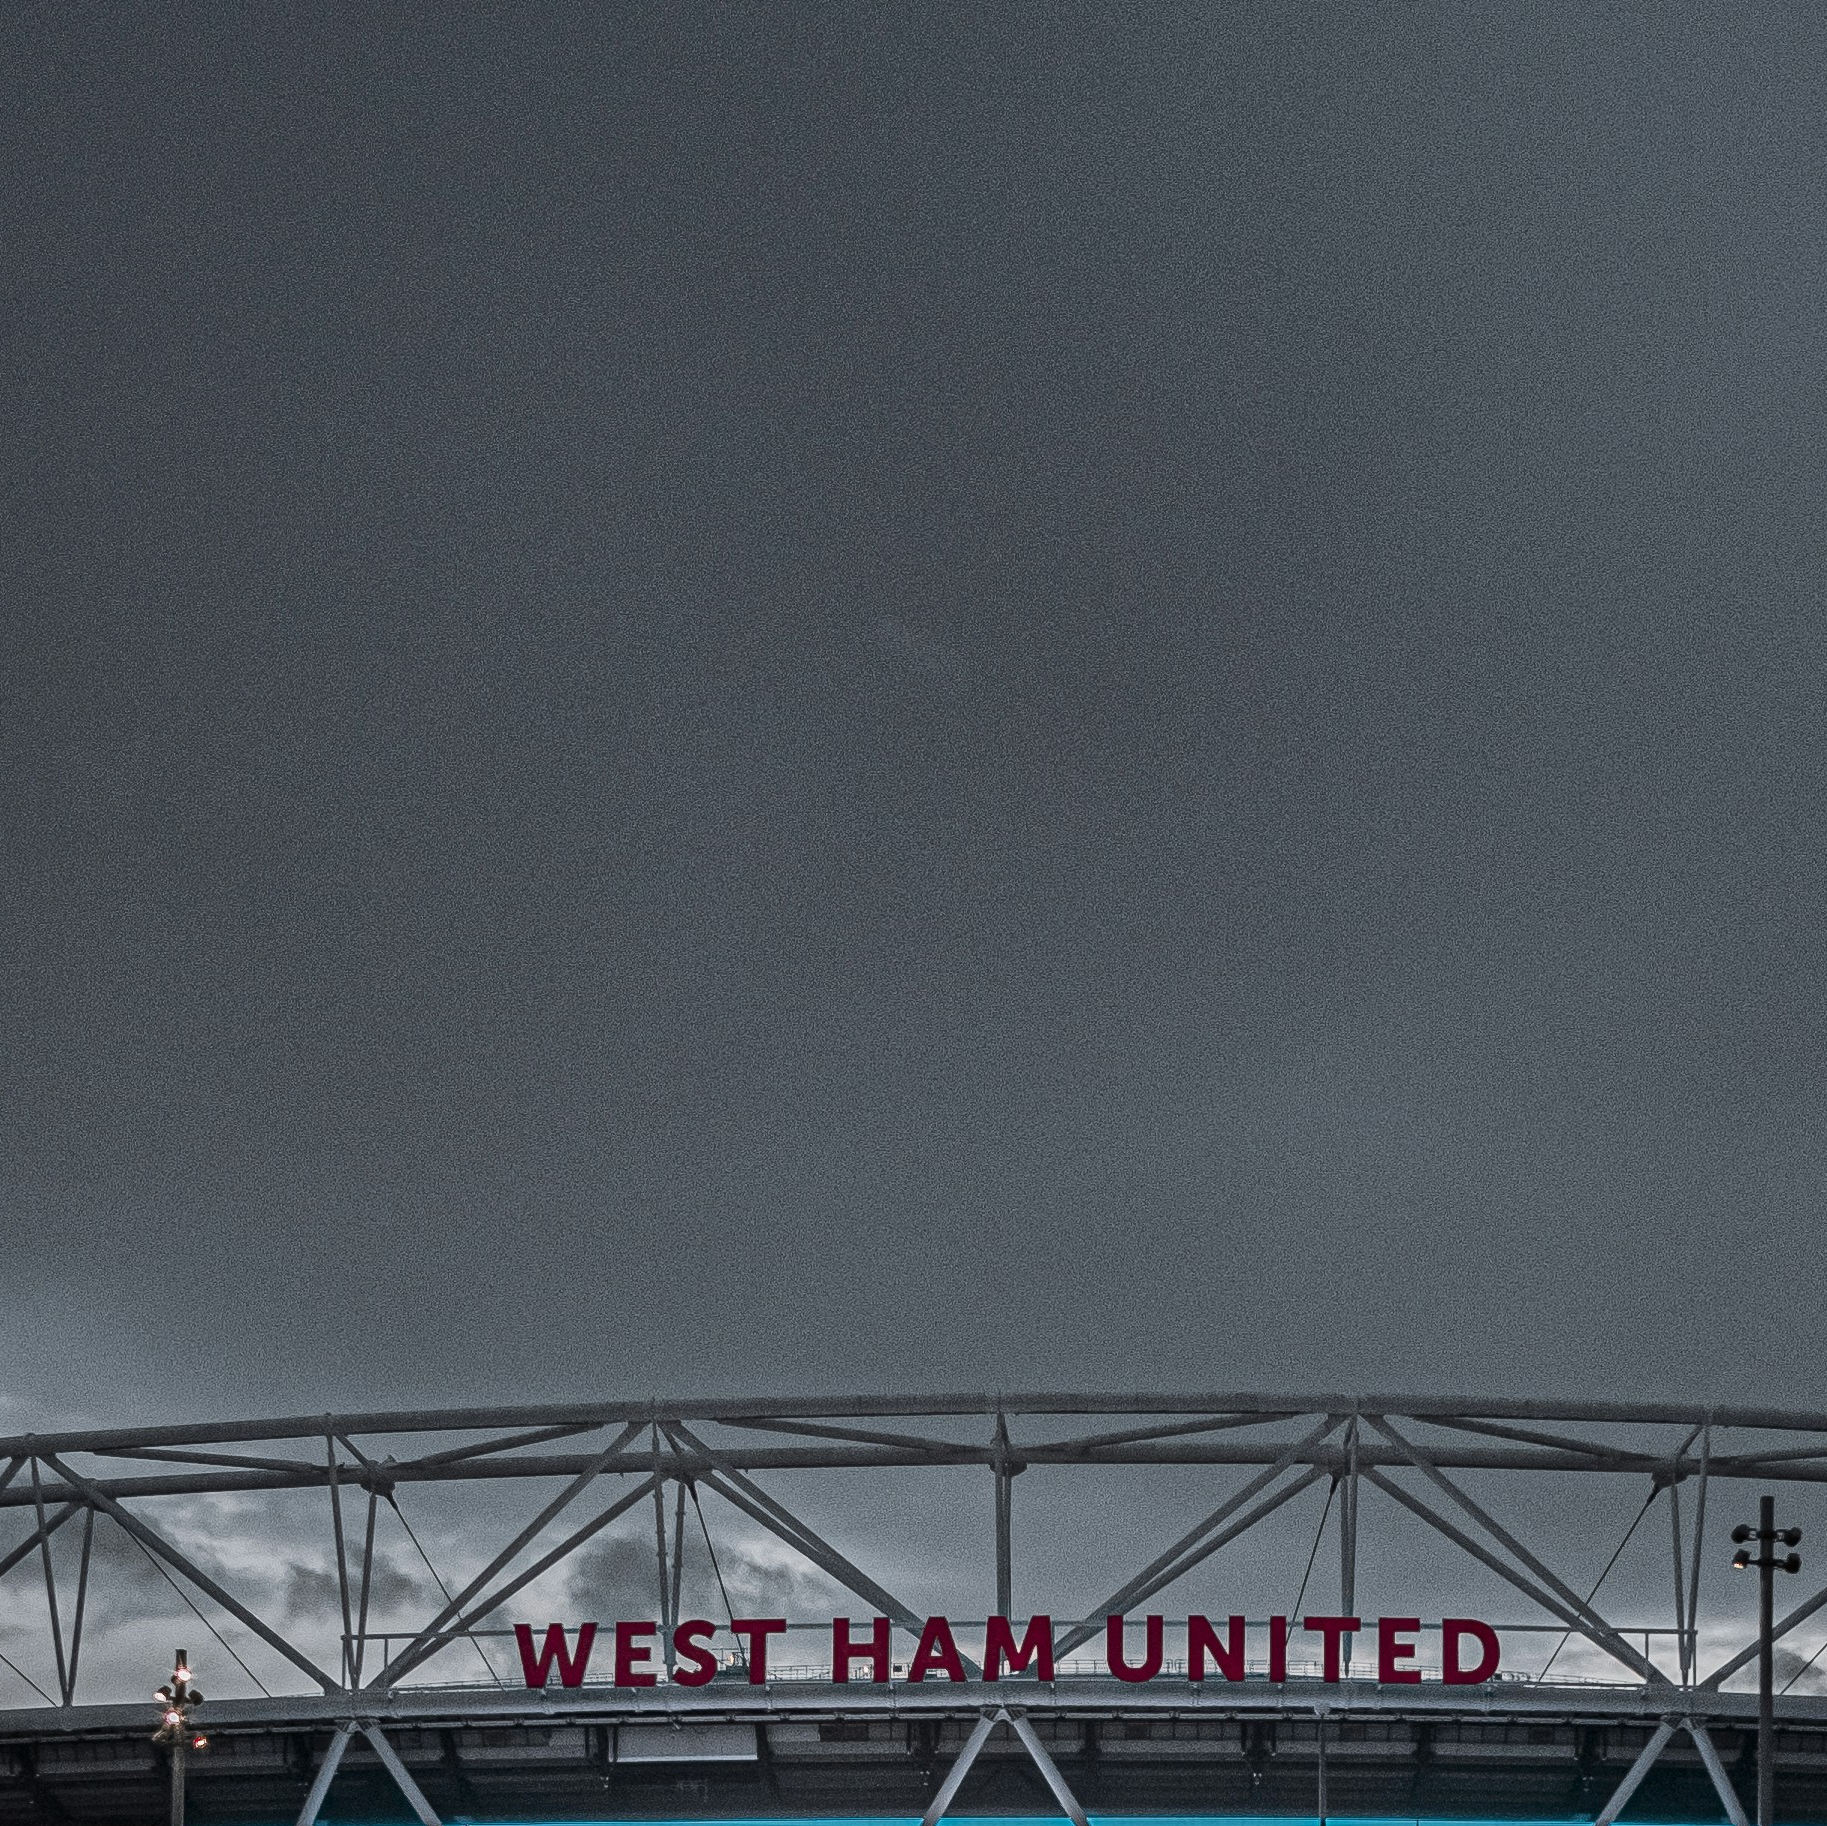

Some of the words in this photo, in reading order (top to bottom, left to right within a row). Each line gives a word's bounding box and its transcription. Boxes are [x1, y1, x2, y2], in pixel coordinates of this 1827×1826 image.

[514, 1619, 787, 1688] WEST
[832, 1616, 1055, 1683] HAM
[1107, 1615, 1501, 1685] UNITED
